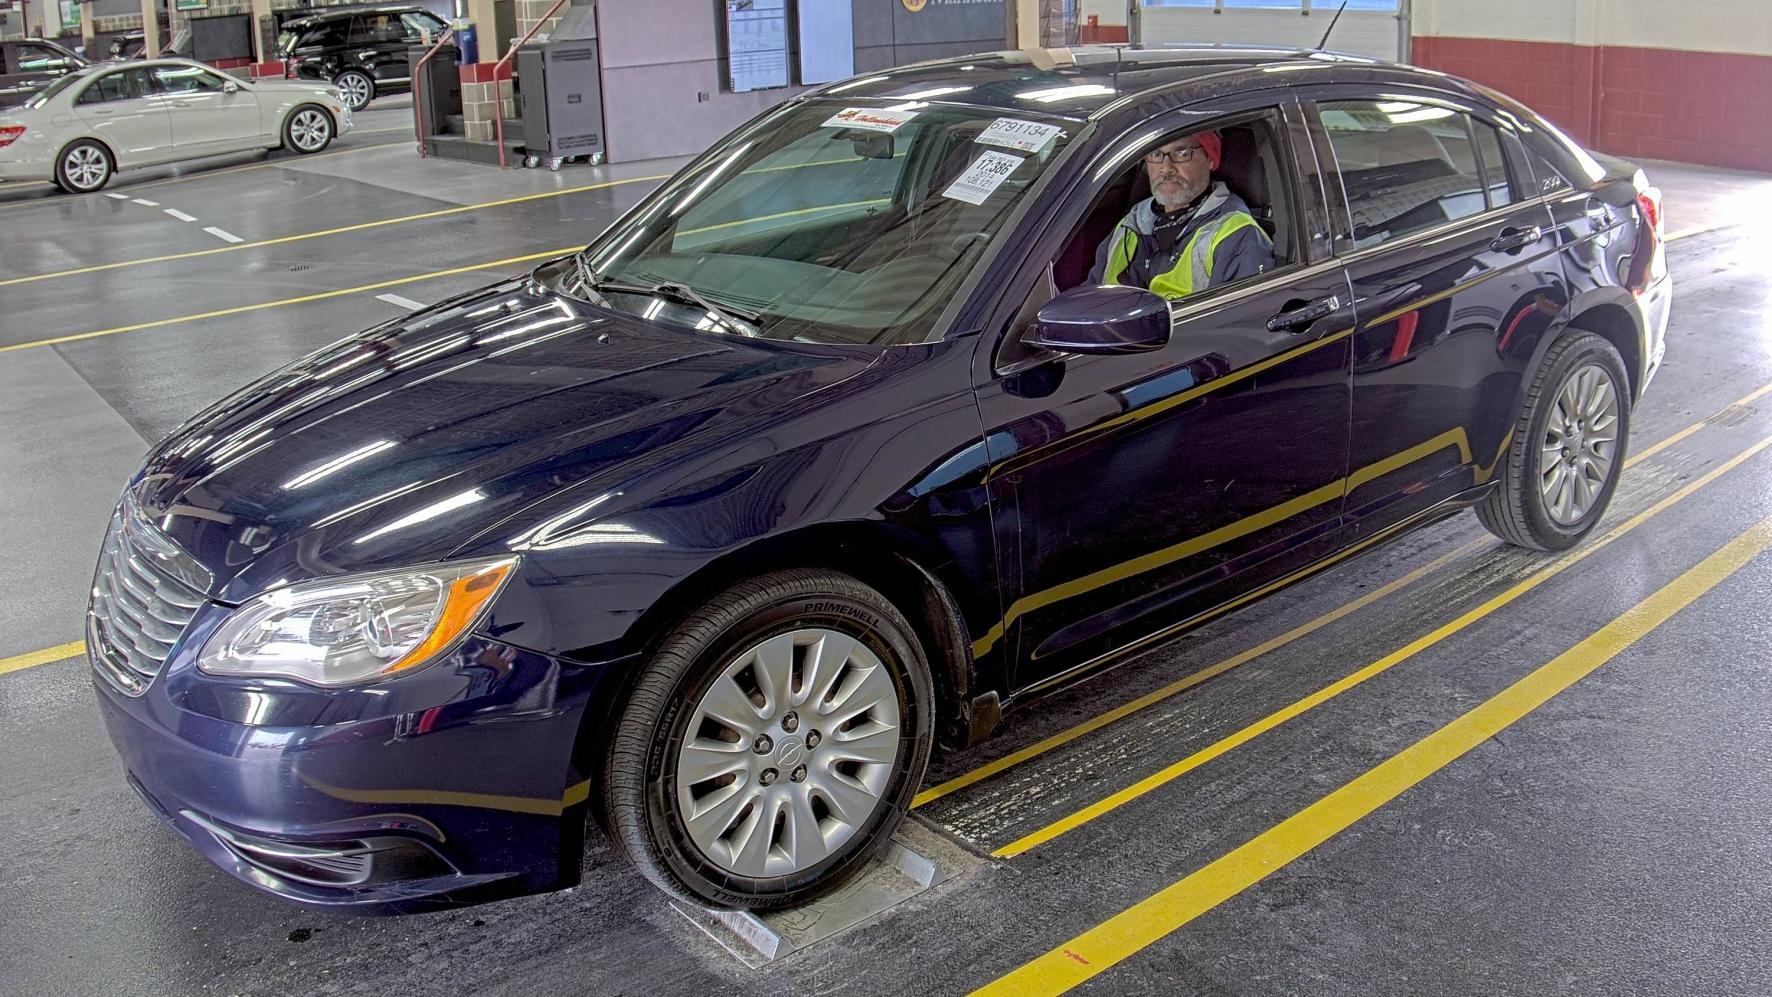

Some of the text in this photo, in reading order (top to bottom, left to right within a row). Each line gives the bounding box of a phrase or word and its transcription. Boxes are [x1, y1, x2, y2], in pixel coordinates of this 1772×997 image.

[990, 120, 1050, 137] 6791134
[976, 170, 996, 179] 2014
[803, 602, 881, 629] PRIMEWELL
